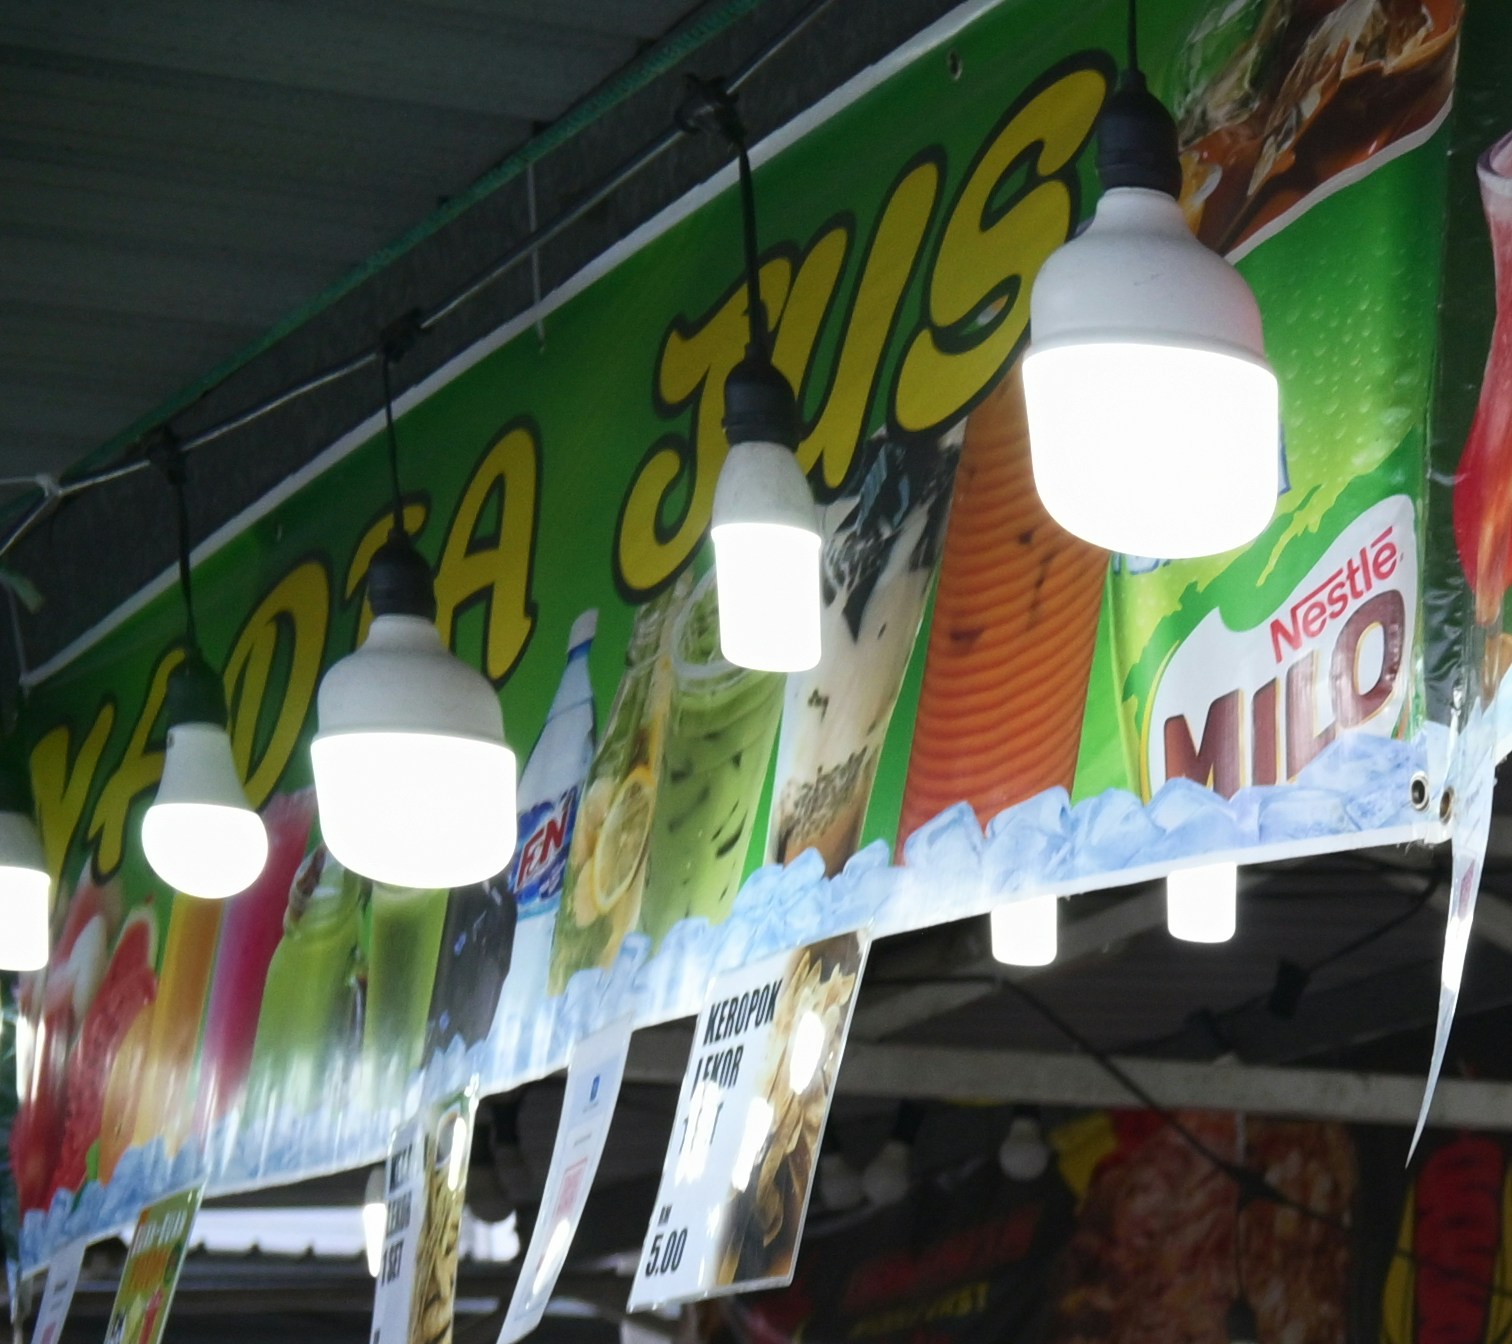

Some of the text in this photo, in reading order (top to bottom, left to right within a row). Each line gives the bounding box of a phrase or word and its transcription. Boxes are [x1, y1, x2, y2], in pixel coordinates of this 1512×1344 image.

[1163, 588, 1406, 801] MILO
[703, 978, 782, 1047] KEROPOK
[644, 1227, 688, 1280] 5.00
